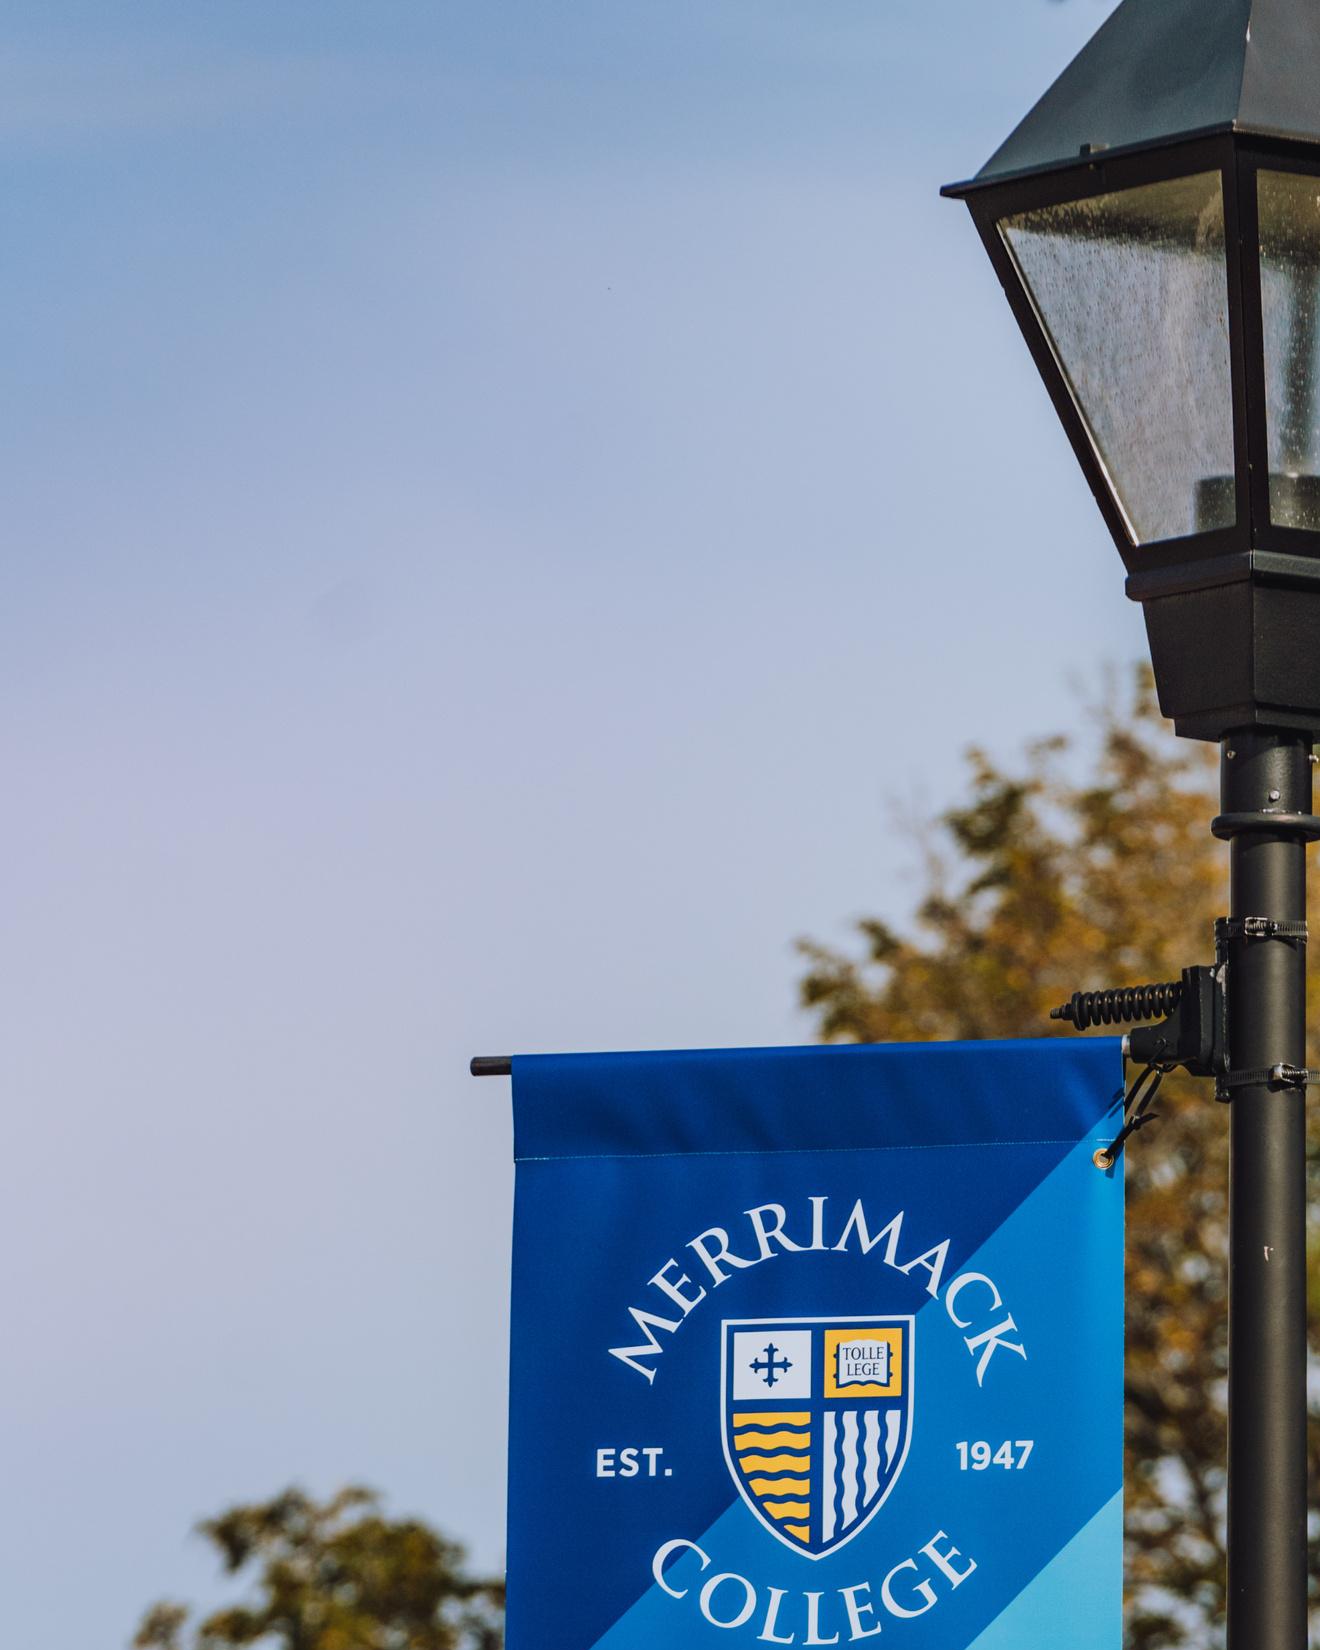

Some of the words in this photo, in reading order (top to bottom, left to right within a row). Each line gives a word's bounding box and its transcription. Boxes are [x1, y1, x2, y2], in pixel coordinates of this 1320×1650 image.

[608, 1196, 1027, 1387] MERRIMACK
[842, 1346, 884, 1361] TOLLE
[846, 1362, 880, 1377] LEGE
[596, 1447, 673, 1478] EST.
[956, 1440, 1034, 1471] 1947
[652, 1530, 978, 1646] COLLEGE
